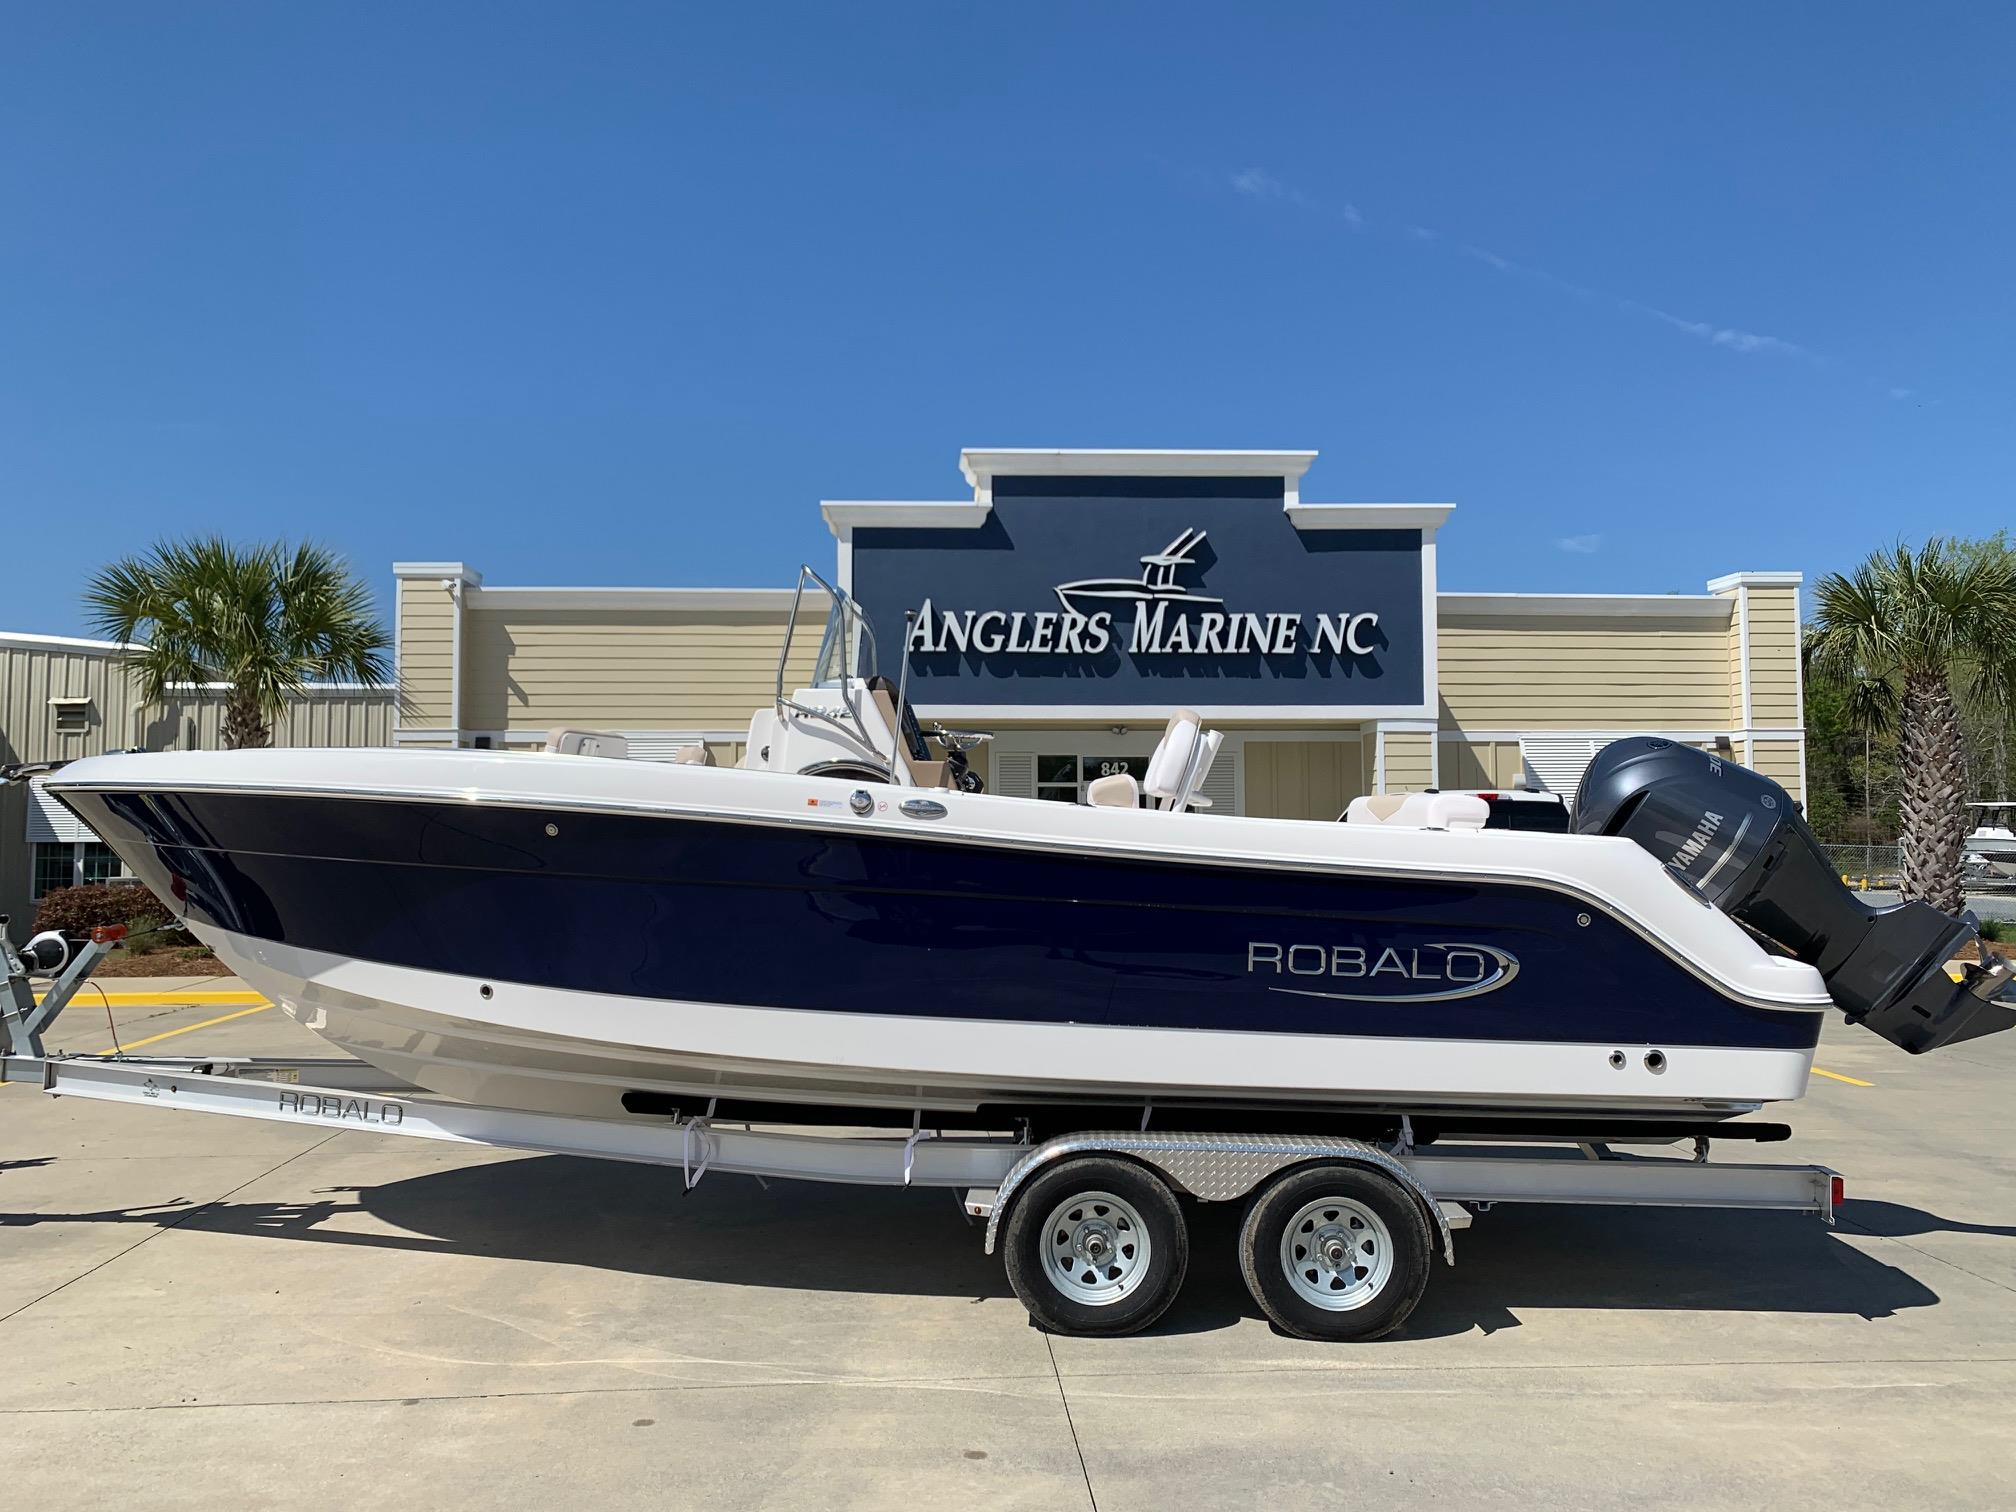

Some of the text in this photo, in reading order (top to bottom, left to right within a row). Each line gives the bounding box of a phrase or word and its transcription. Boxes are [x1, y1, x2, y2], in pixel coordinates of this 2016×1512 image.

[905, 598, 1379, 655] ANGLERS MARINE NC
[1100, 761, 1129, 776] 842
[1667, 810, 1724, 871] YAMAHA
[1247, 941, 1485, 982] ROBALO
[279, 1091, 404, 1126] ROBALO
